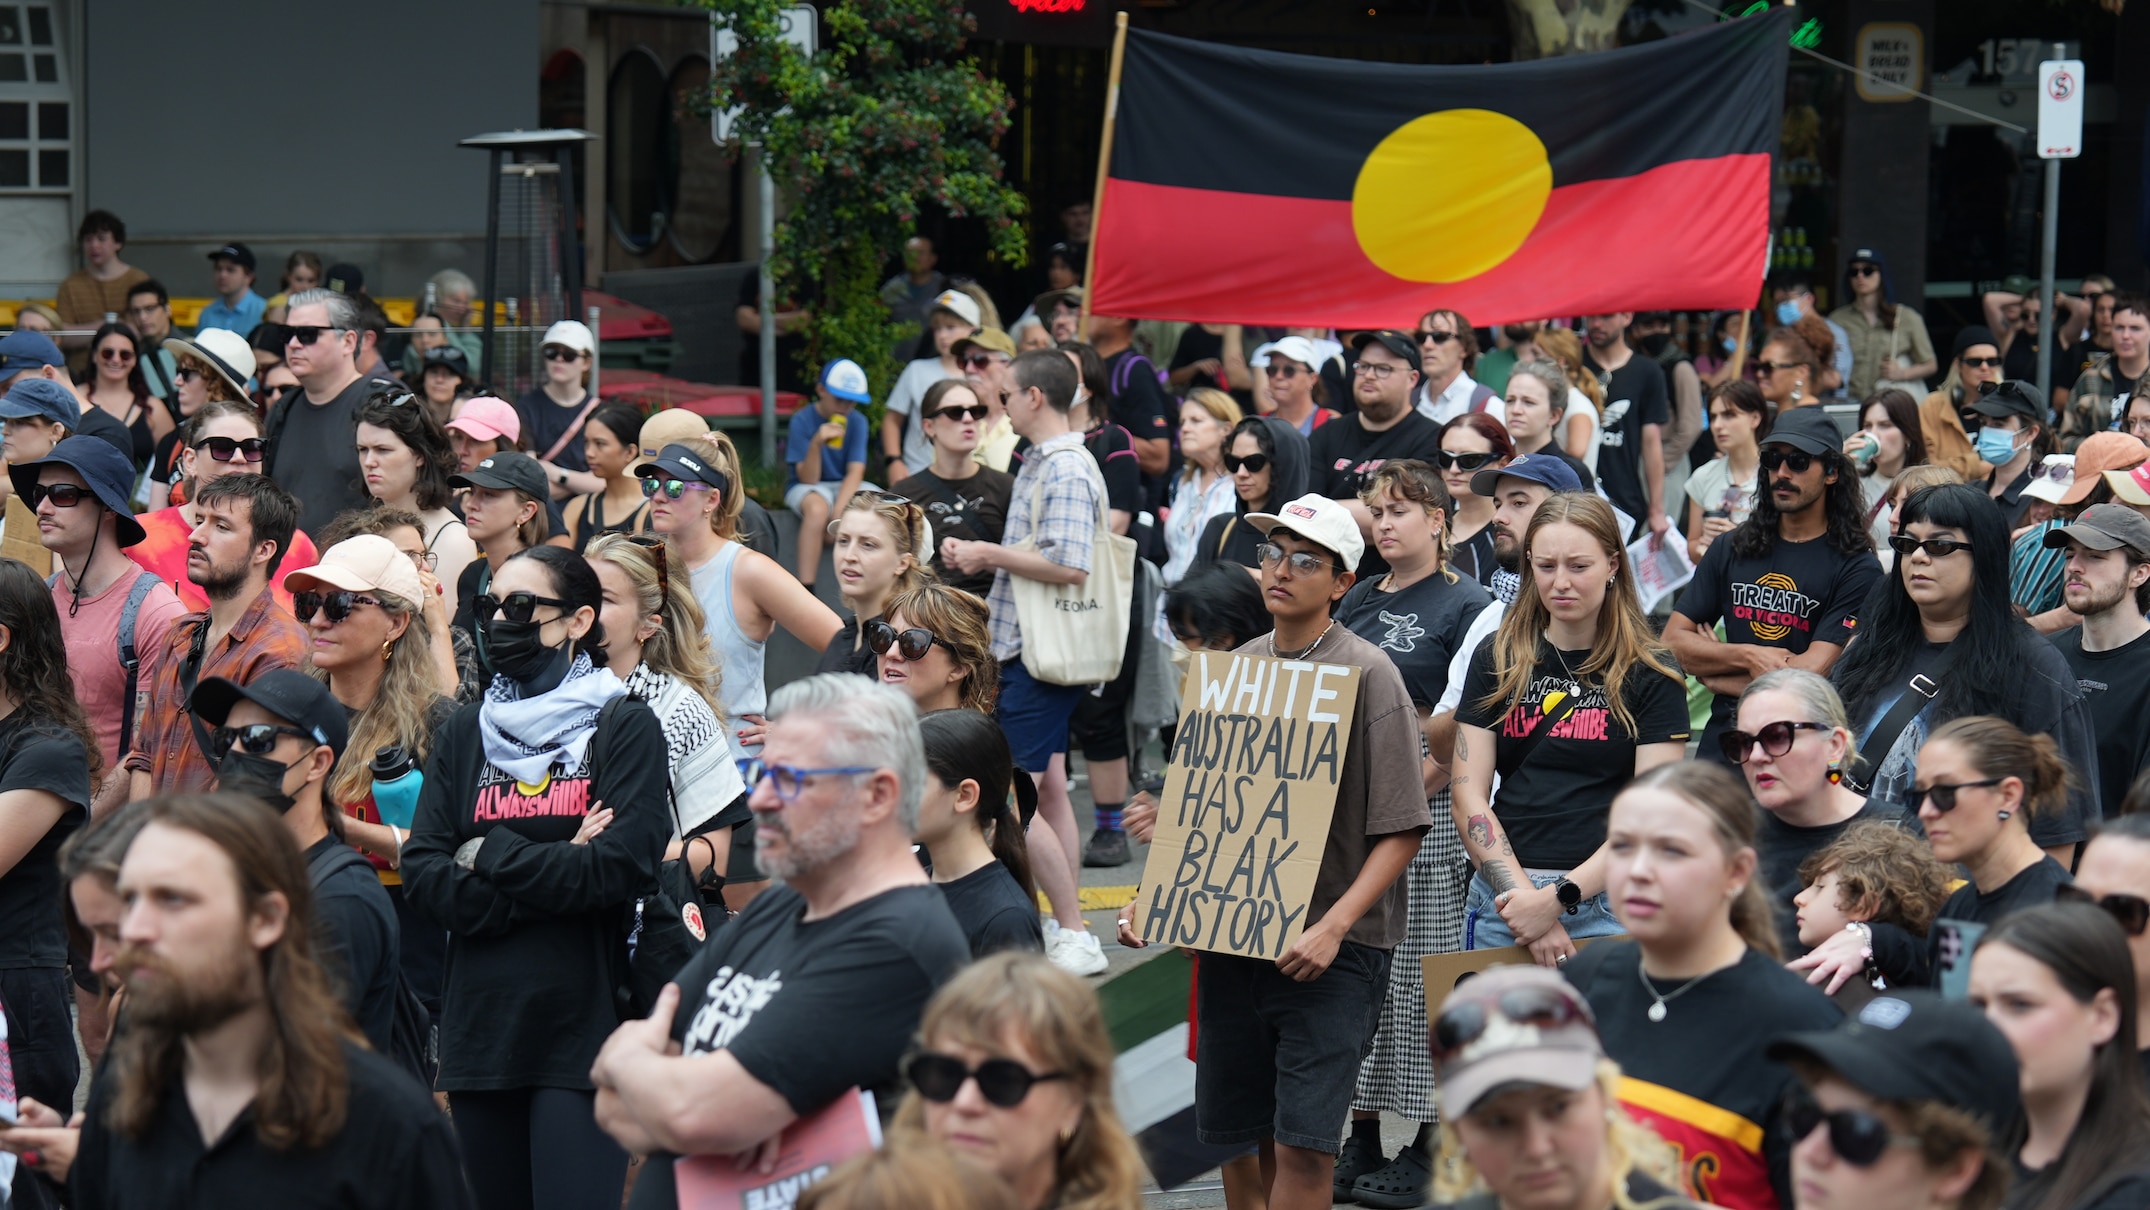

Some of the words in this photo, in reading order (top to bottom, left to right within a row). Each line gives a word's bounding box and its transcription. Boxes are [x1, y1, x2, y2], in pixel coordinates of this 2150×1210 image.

[1978, 38, 2041, 75] 157
[1731, 582, 1820, 618] TREATY
[1733, 605, 1753, 620] OR
[1199, 653, 1350, 723] WHITE
[1171, 709, 1338, 785] AUSTRALIA
[1178, 769, 1254, 834] HAS
[1255, 780, 1289, 840] A
[1175, 829, 1299, 901] BLAK
[1143, 884, 1305, 958] HISTORY
